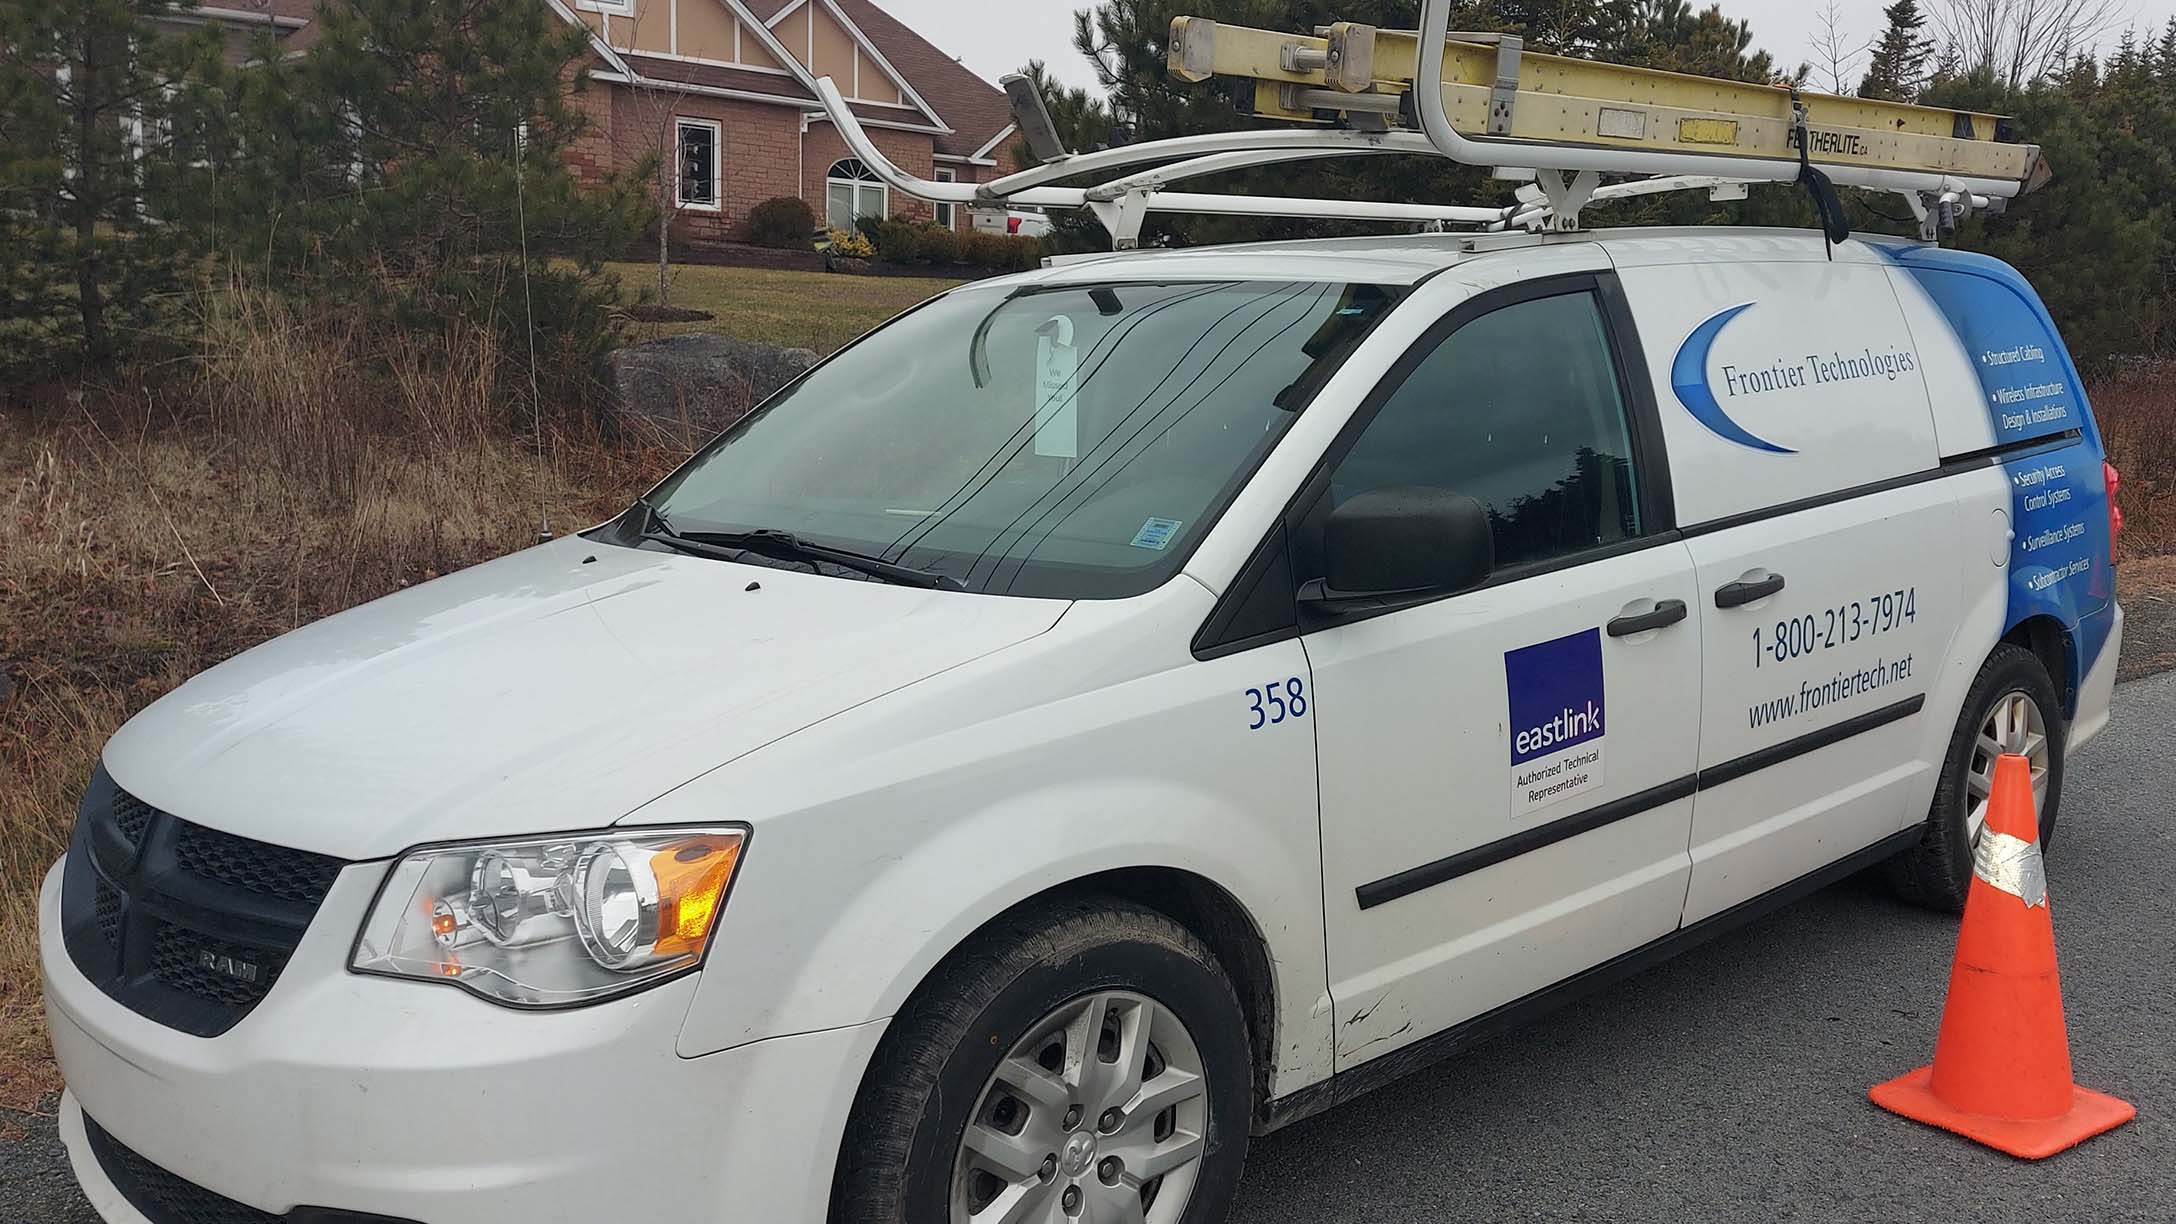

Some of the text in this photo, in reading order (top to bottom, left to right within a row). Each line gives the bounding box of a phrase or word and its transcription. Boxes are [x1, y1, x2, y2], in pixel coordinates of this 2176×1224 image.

[1987, 344, 2045, 365] Structured Cabling
[1722, 345, 1915, 397] Frontier Technologies
[1997, 382, 2064, 404] Wireless Infrastructure
[2002, 404, 2067, 431] Design & Installations
[2018, 464, 2065, 487] Security Access
[2024, 487, 2071, 511] Control Systems
[2028, 522, 2085, 551] Surveillance Systems
[2068, 557, 2090, 577] Services
[1752, 587, 1916, 668] 1-800-213-7974
[1245, 677, 1307, 730] 358
[1749, 652, 1913, 729] www.frontiertech.net
[1516, 700, 1601, 755] eastlink
[1516, 748, 1599, 788] Authorized Technical
[1528, 773, 1589, 803] Representative
[200, 949, 257, 981] RAM
